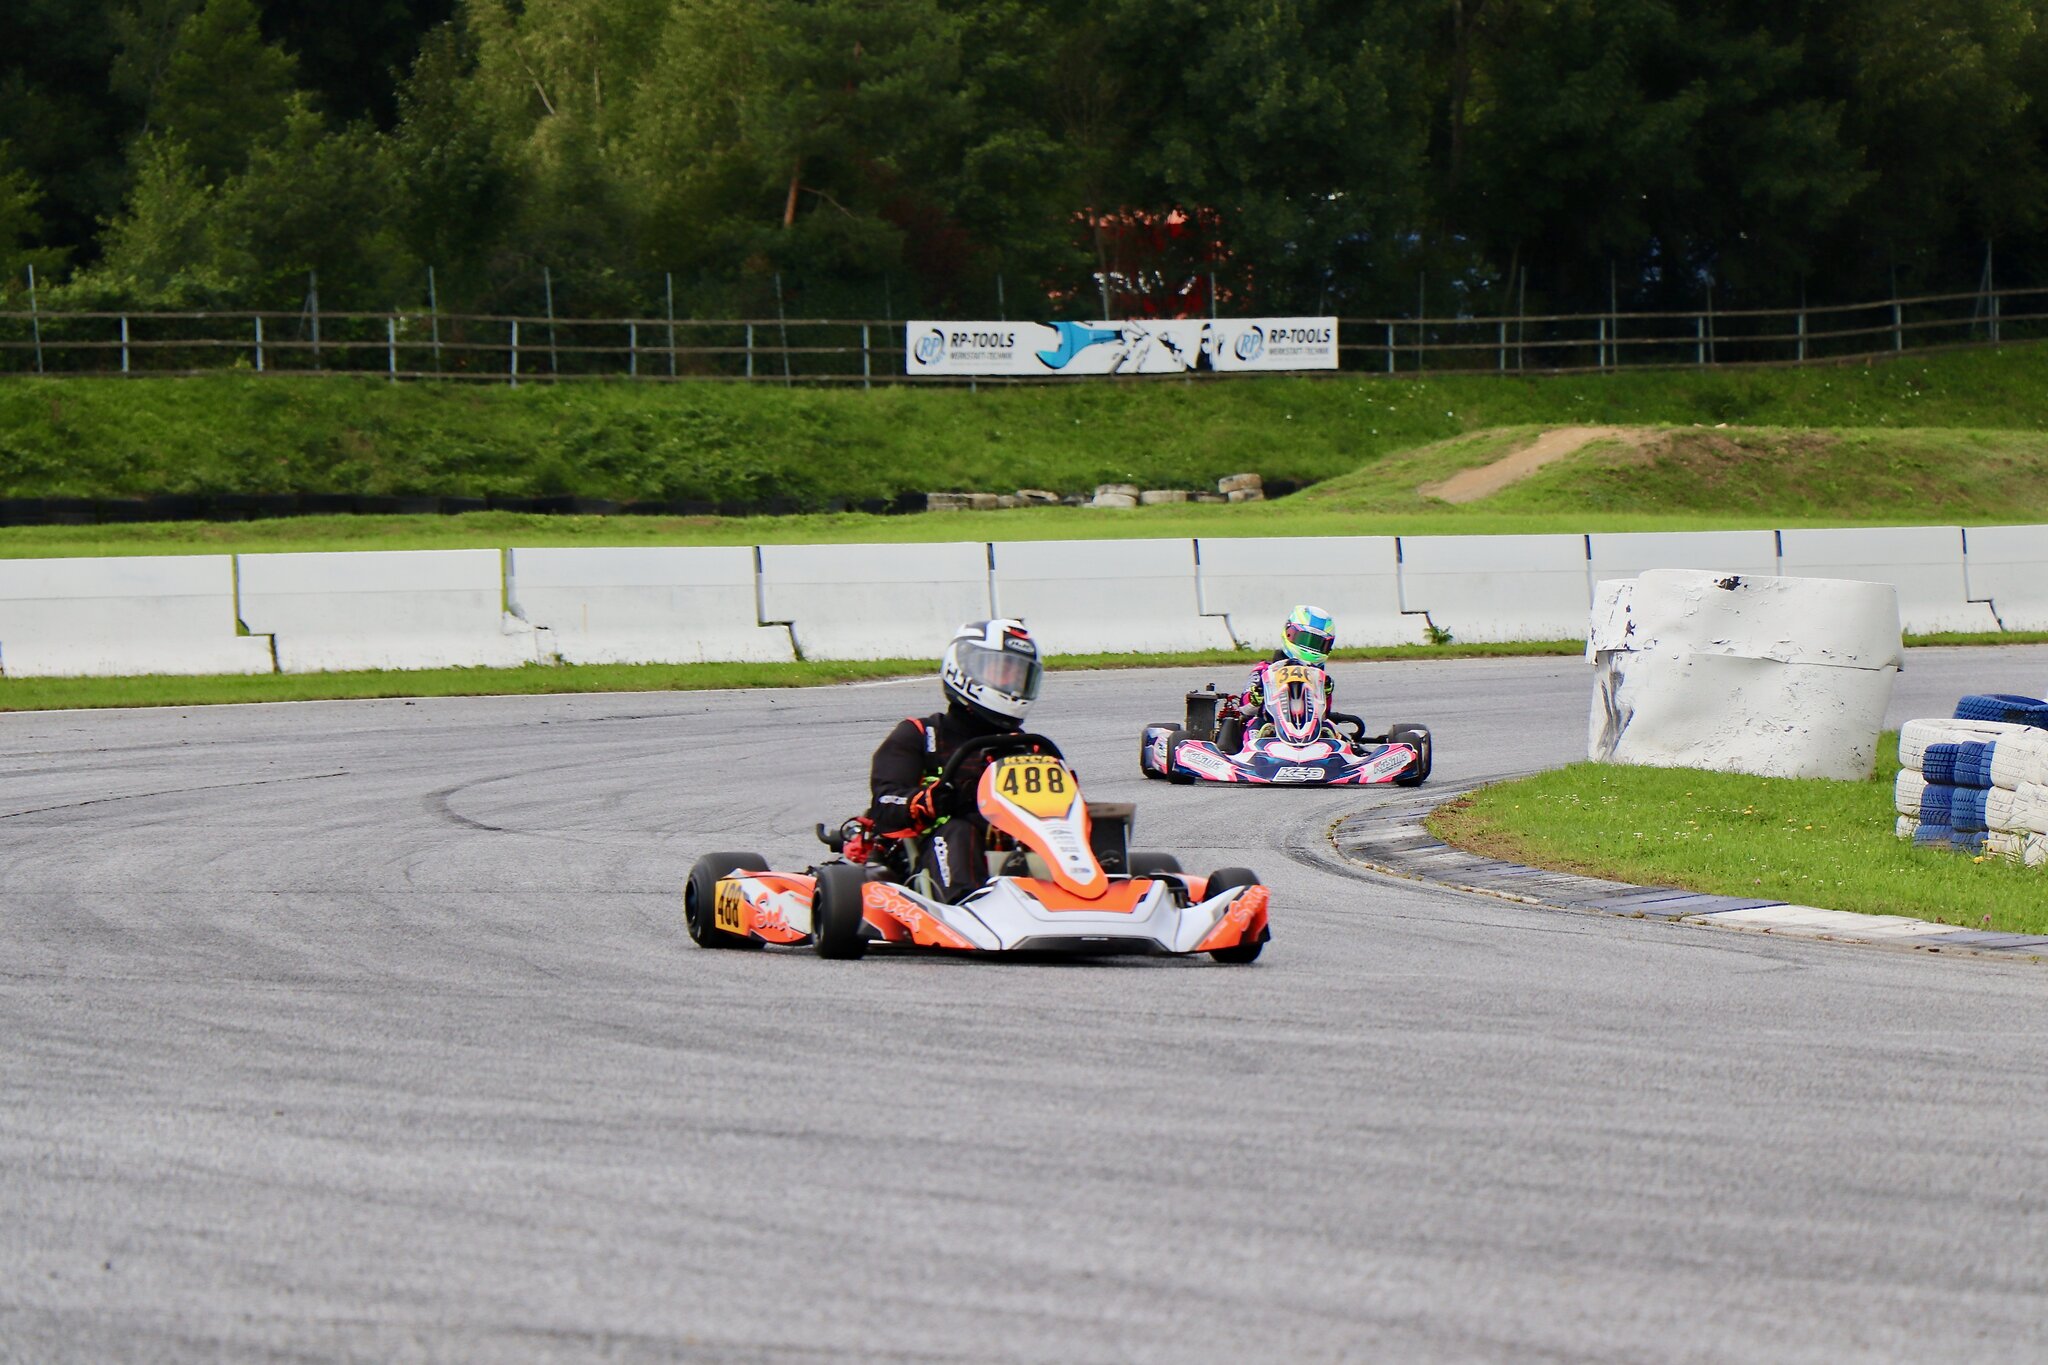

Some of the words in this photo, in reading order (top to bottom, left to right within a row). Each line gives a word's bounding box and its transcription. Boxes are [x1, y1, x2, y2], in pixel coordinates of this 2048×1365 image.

[950, 333, 1015, 348] RP-TOOLS
[1269, 328, 1331, 343] RP-TOOLS
[1003, 766, 1064, 795] 488
[717, 880, 740, 929] 488
